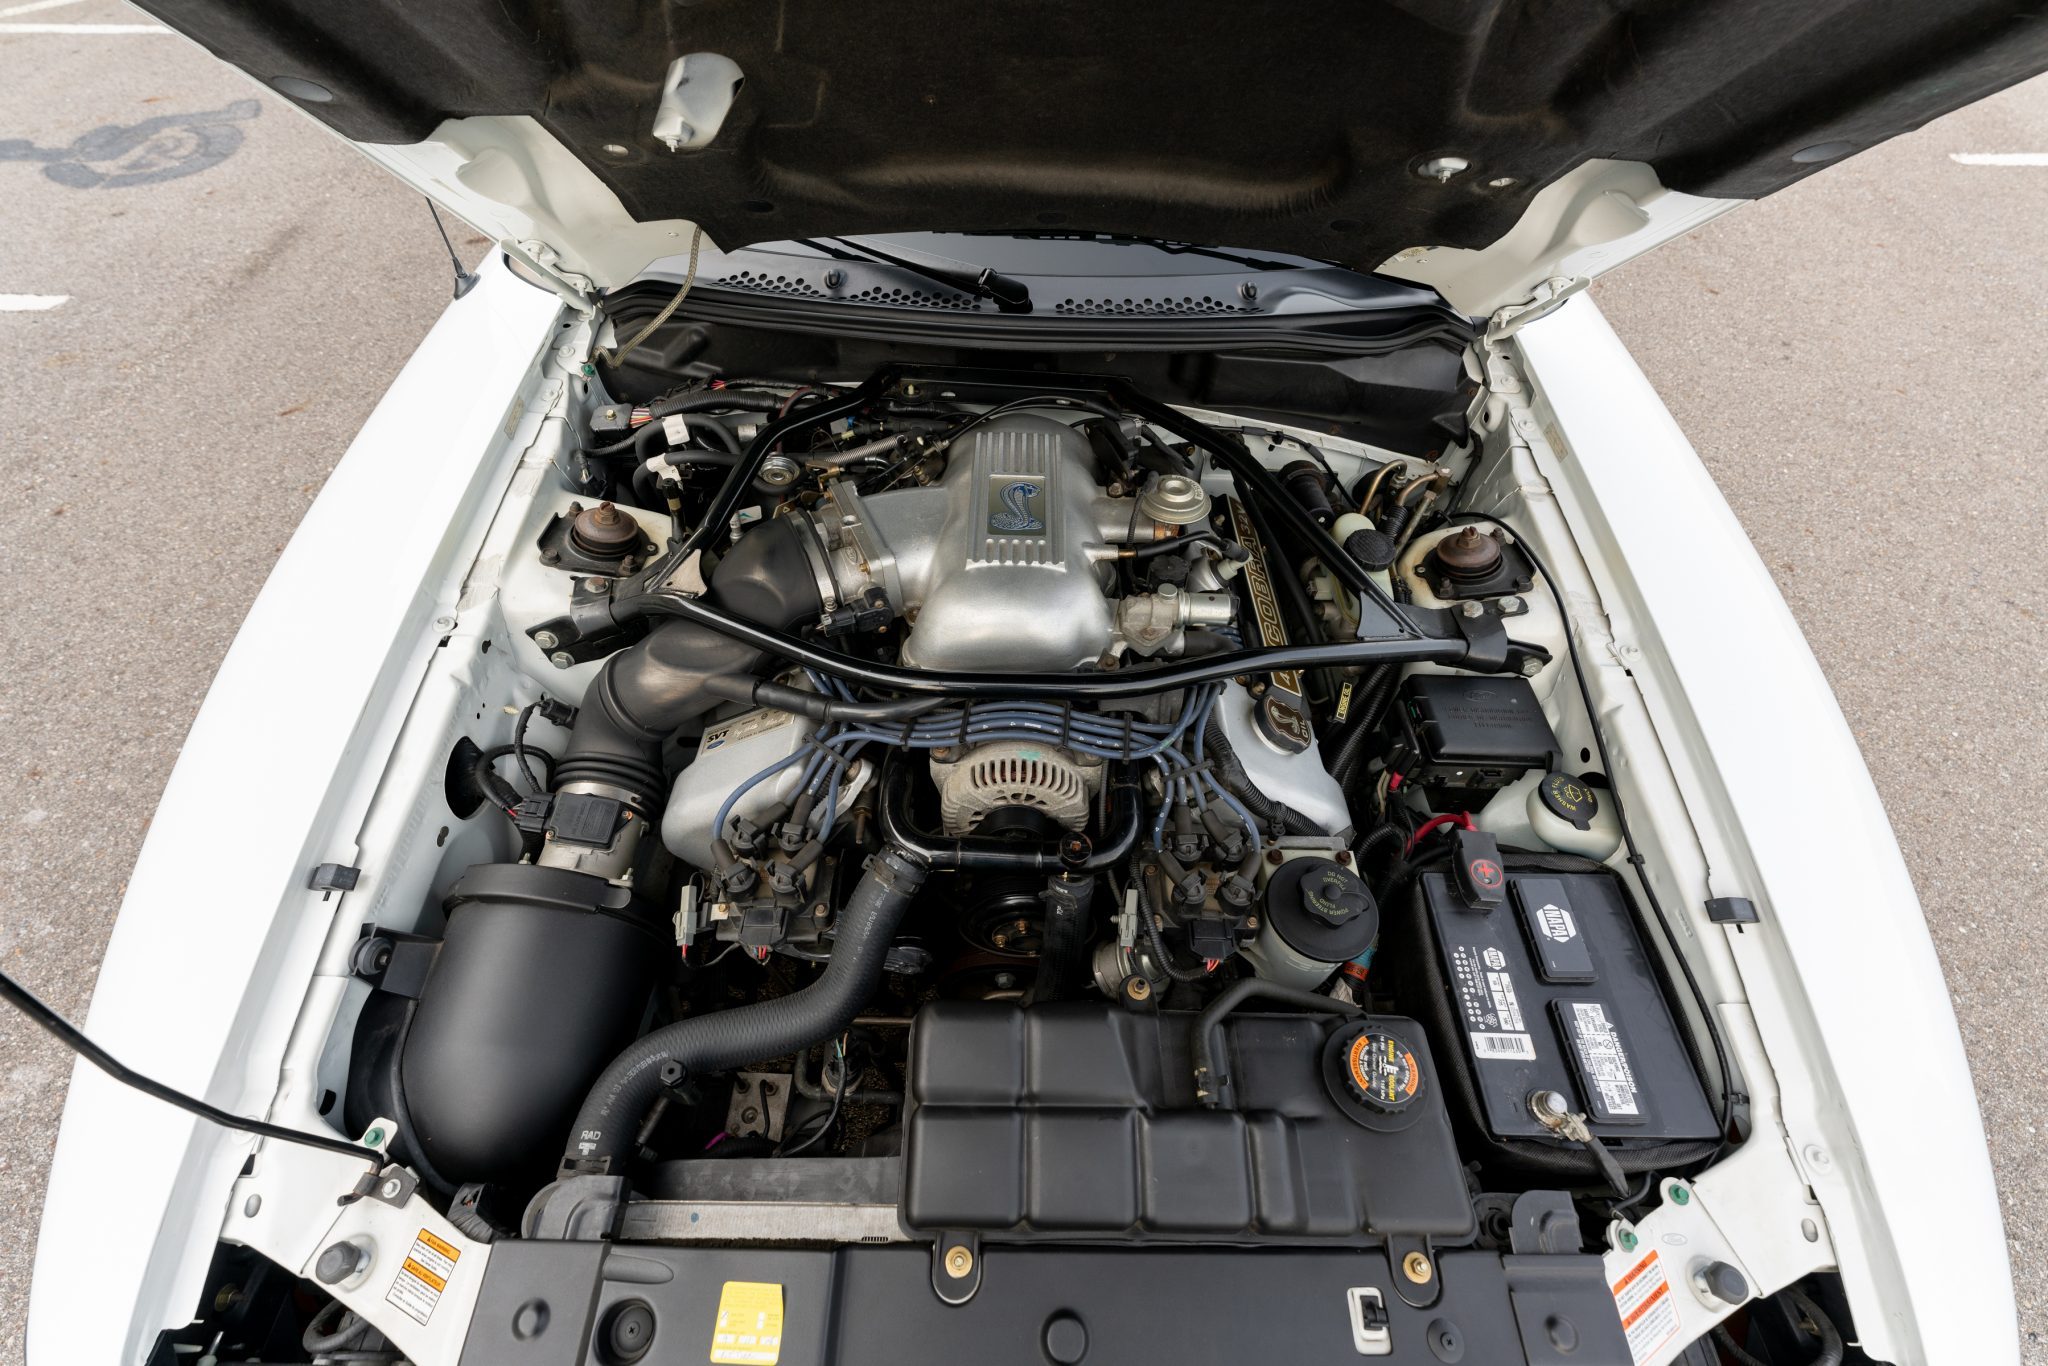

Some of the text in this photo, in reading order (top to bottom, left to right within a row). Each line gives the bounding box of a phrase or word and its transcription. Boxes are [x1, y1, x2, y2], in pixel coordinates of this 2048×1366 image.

[1241, 537, 1284, 646] COBRA
[707, 730, 729, 742] SVT
[1300, 720, 1308, 738] OIL
[1553, 790, 1576, 811] WASHER
[1323, 877, 1346, 890] OVERFILL
[1337, 874, 1348, 883] NOT
[1308, 890, 1349, 915] POWER STEERING
[1320, 899, 1336, 909] FLUID
[1352, 1043, 1364, 1084] AVERTISSEMENT
[1610, 1031, 1637, 1093] DANGER/POISON
[1388, 1075, 1396, 1101] COOLANT
[1408, 1063, 1417, 1092] WARNING
[581, 1130, 601, 1140] RAD
